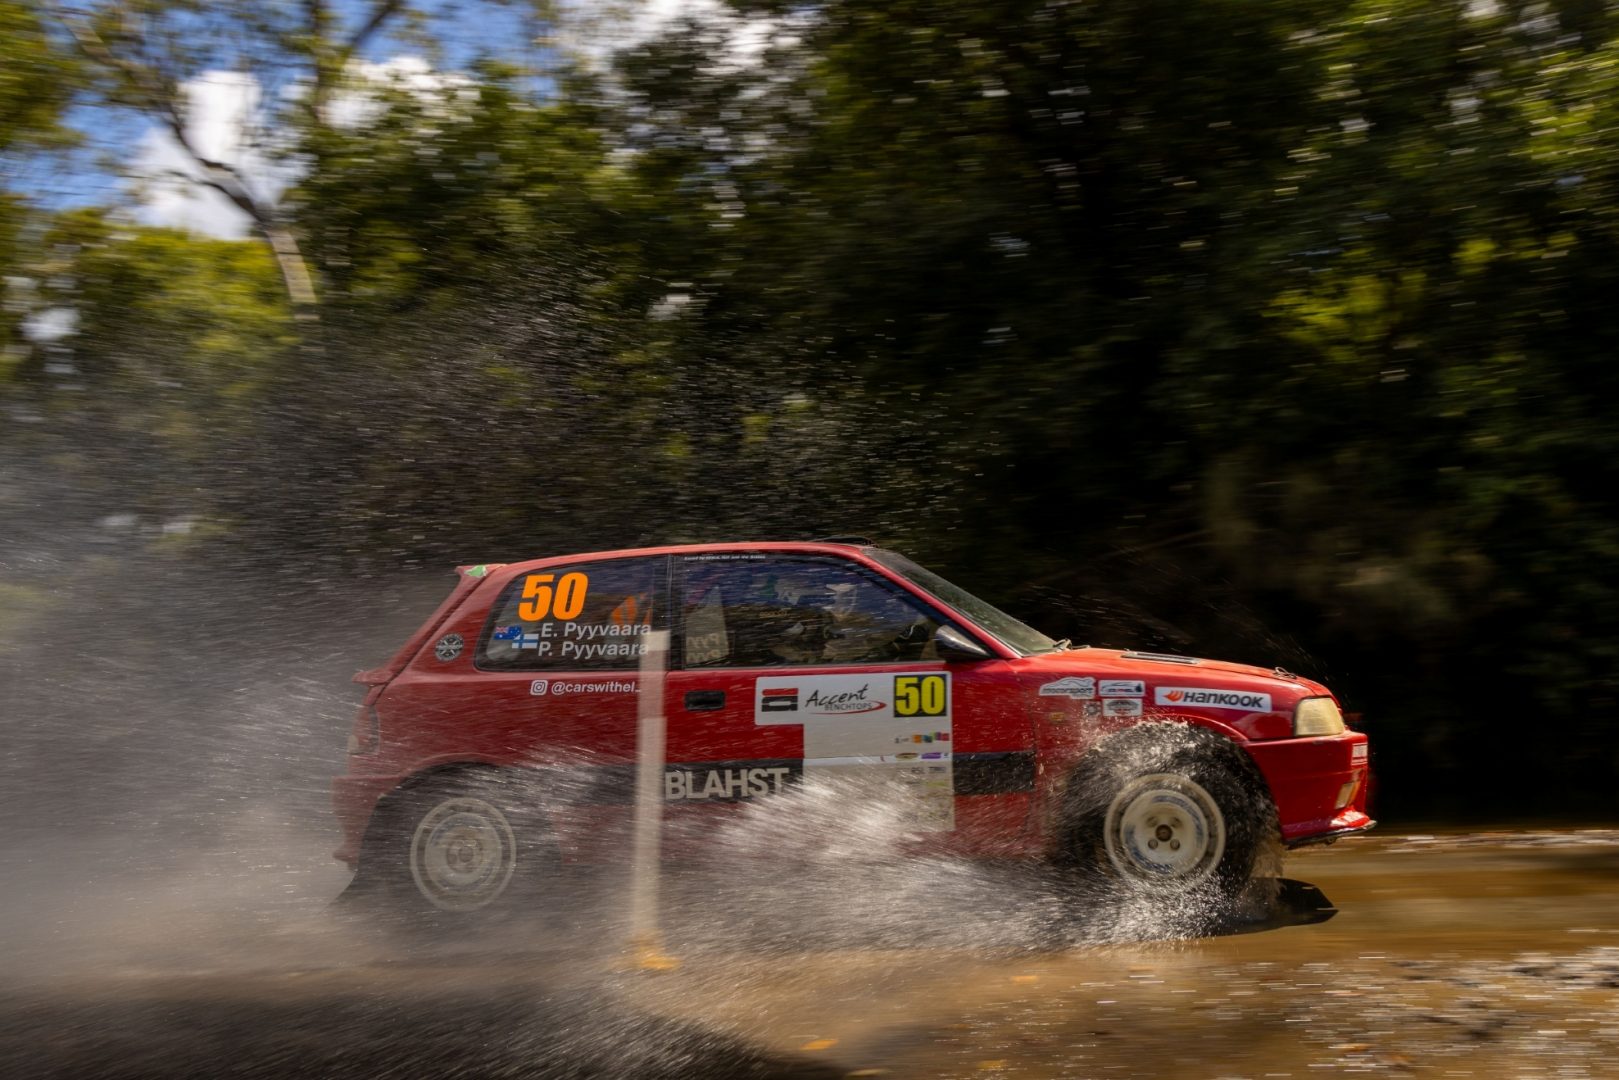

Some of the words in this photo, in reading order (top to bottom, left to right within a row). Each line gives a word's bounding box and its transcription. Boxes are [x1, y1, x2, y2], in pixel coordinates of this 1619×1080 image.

[518, 572, 588, 621] 50
[541, 623, 558, 637] E.
[564, 622, 651, 640] Pyyvaara
[538, 642, 553, 656] P.
[561, 641, 649, 660] Pyyvaara
[805, 684, 868, 708] Accent
[895, 677, 945, 715] 50
[824, 702, 872, 711] BENCHTOPS
[665, 767, 789, 800] BLAHST
